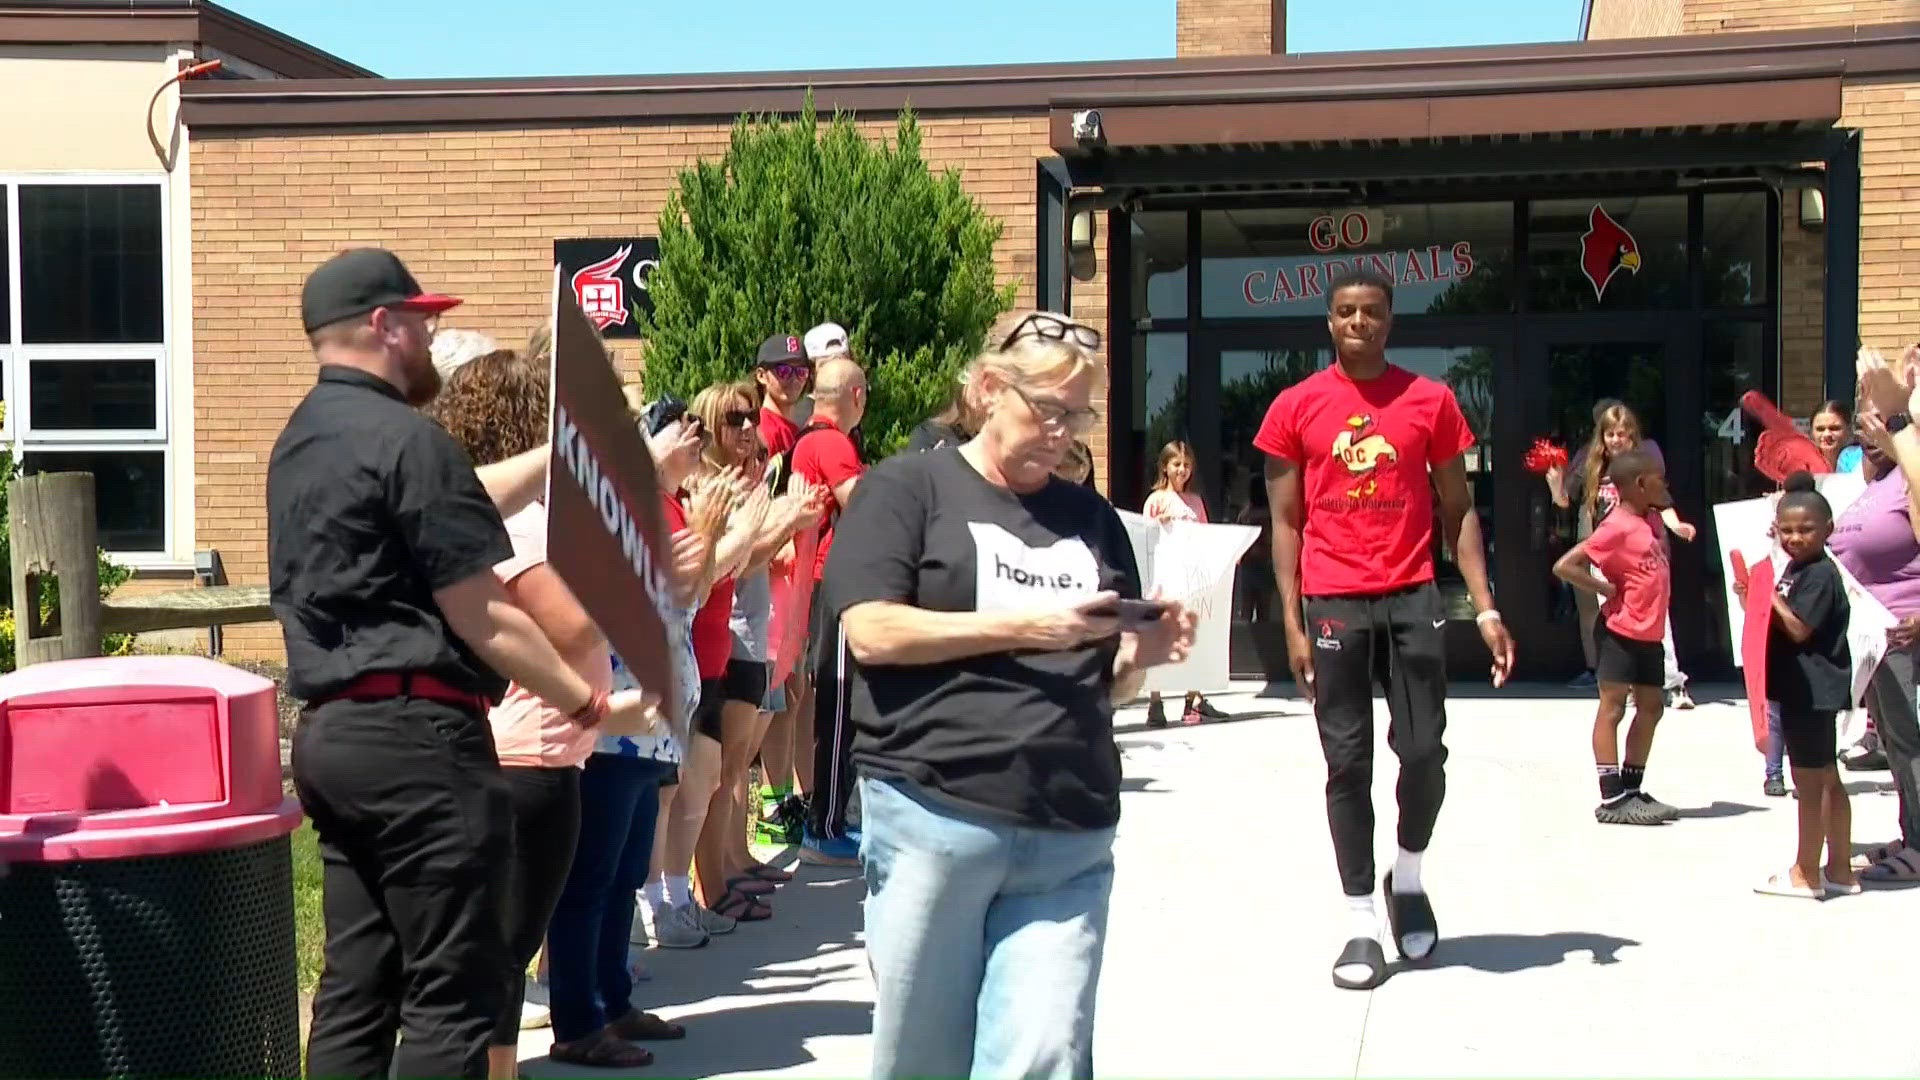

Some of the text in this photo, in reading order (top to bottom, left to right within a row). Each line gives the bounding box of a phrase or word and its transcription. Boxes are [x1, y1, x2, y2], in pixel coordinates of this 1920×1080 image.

[1309, 211, 1369, 252] GO
[1242, 241, 1475, 305] CARDINALS
[1718, 407, 1745, 444] 4
[995, 552, 1083, 589] home.
